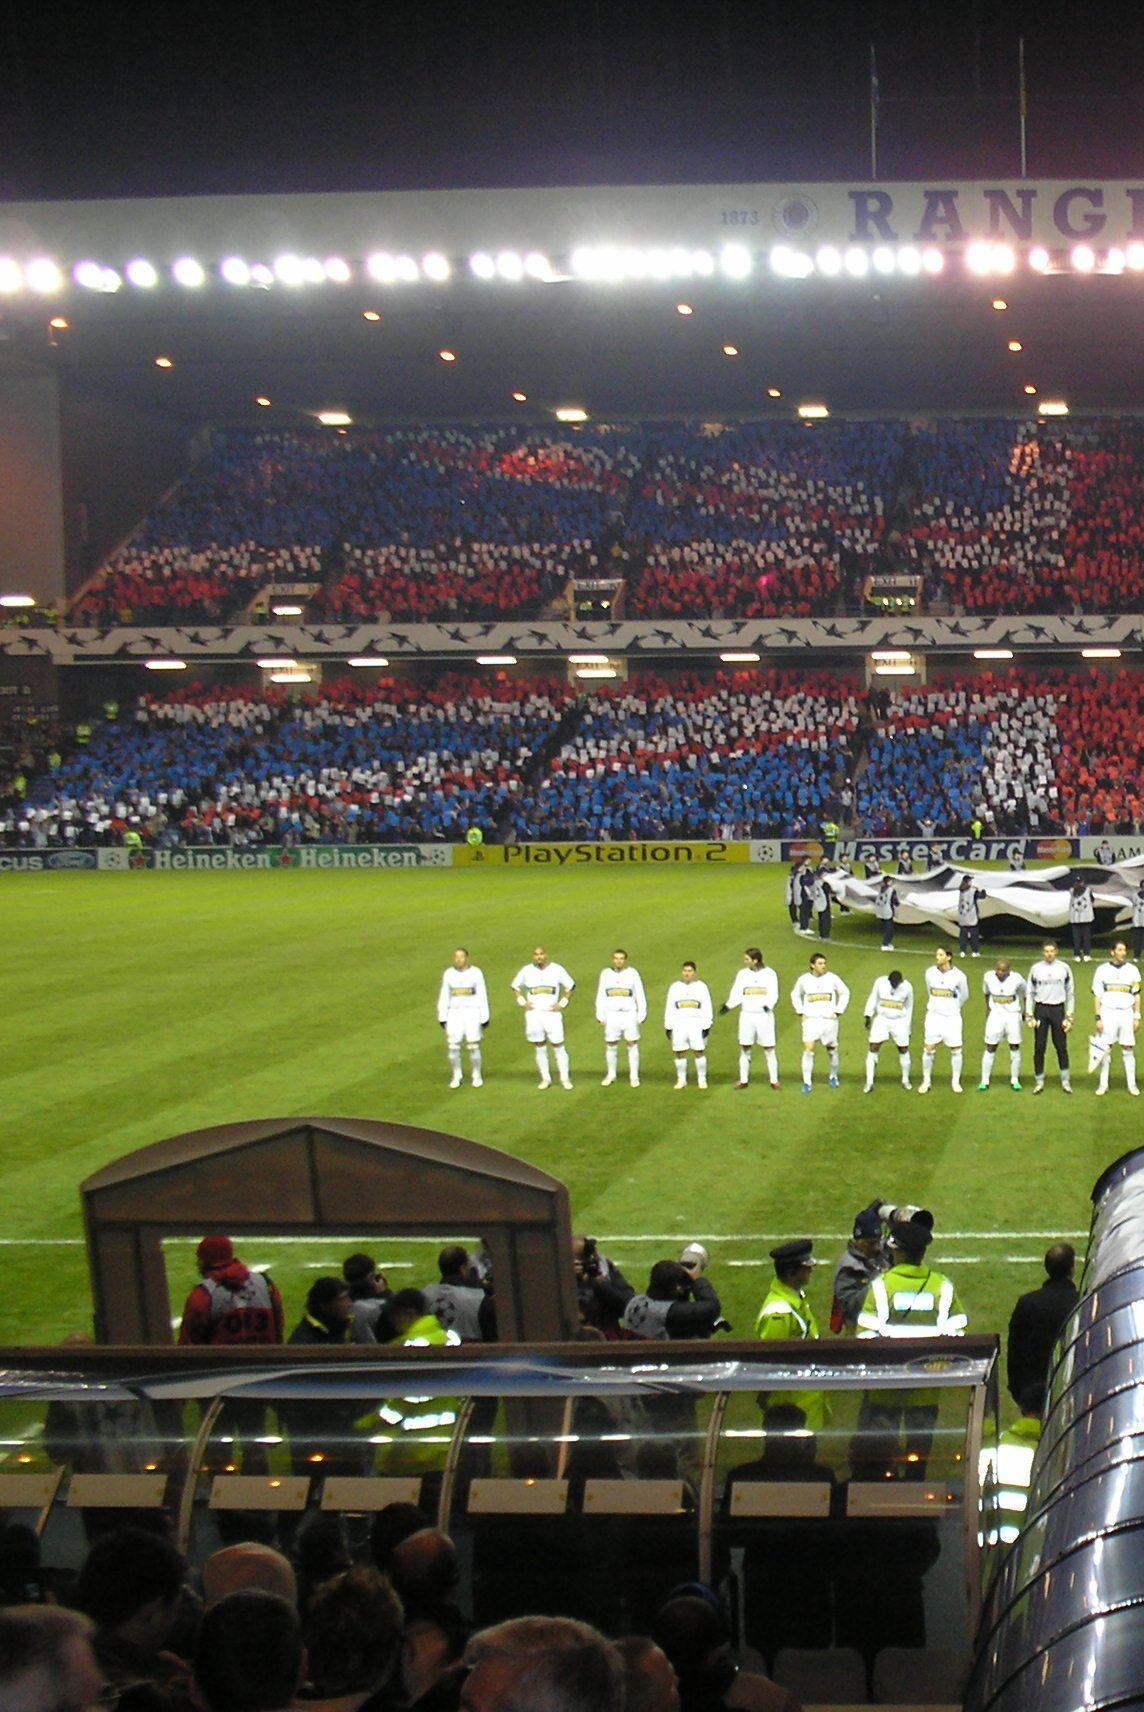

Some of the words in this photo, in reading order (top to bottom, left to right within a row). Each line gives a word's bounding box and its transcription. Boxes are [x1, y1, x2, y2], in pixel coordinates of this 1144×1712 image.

[154, 850, 272, 869] Heineken
[299, 848, 418, 868] Heineken
[503, 844, 692, 865] PlayStation
[705, 842, 727, 861] 2
